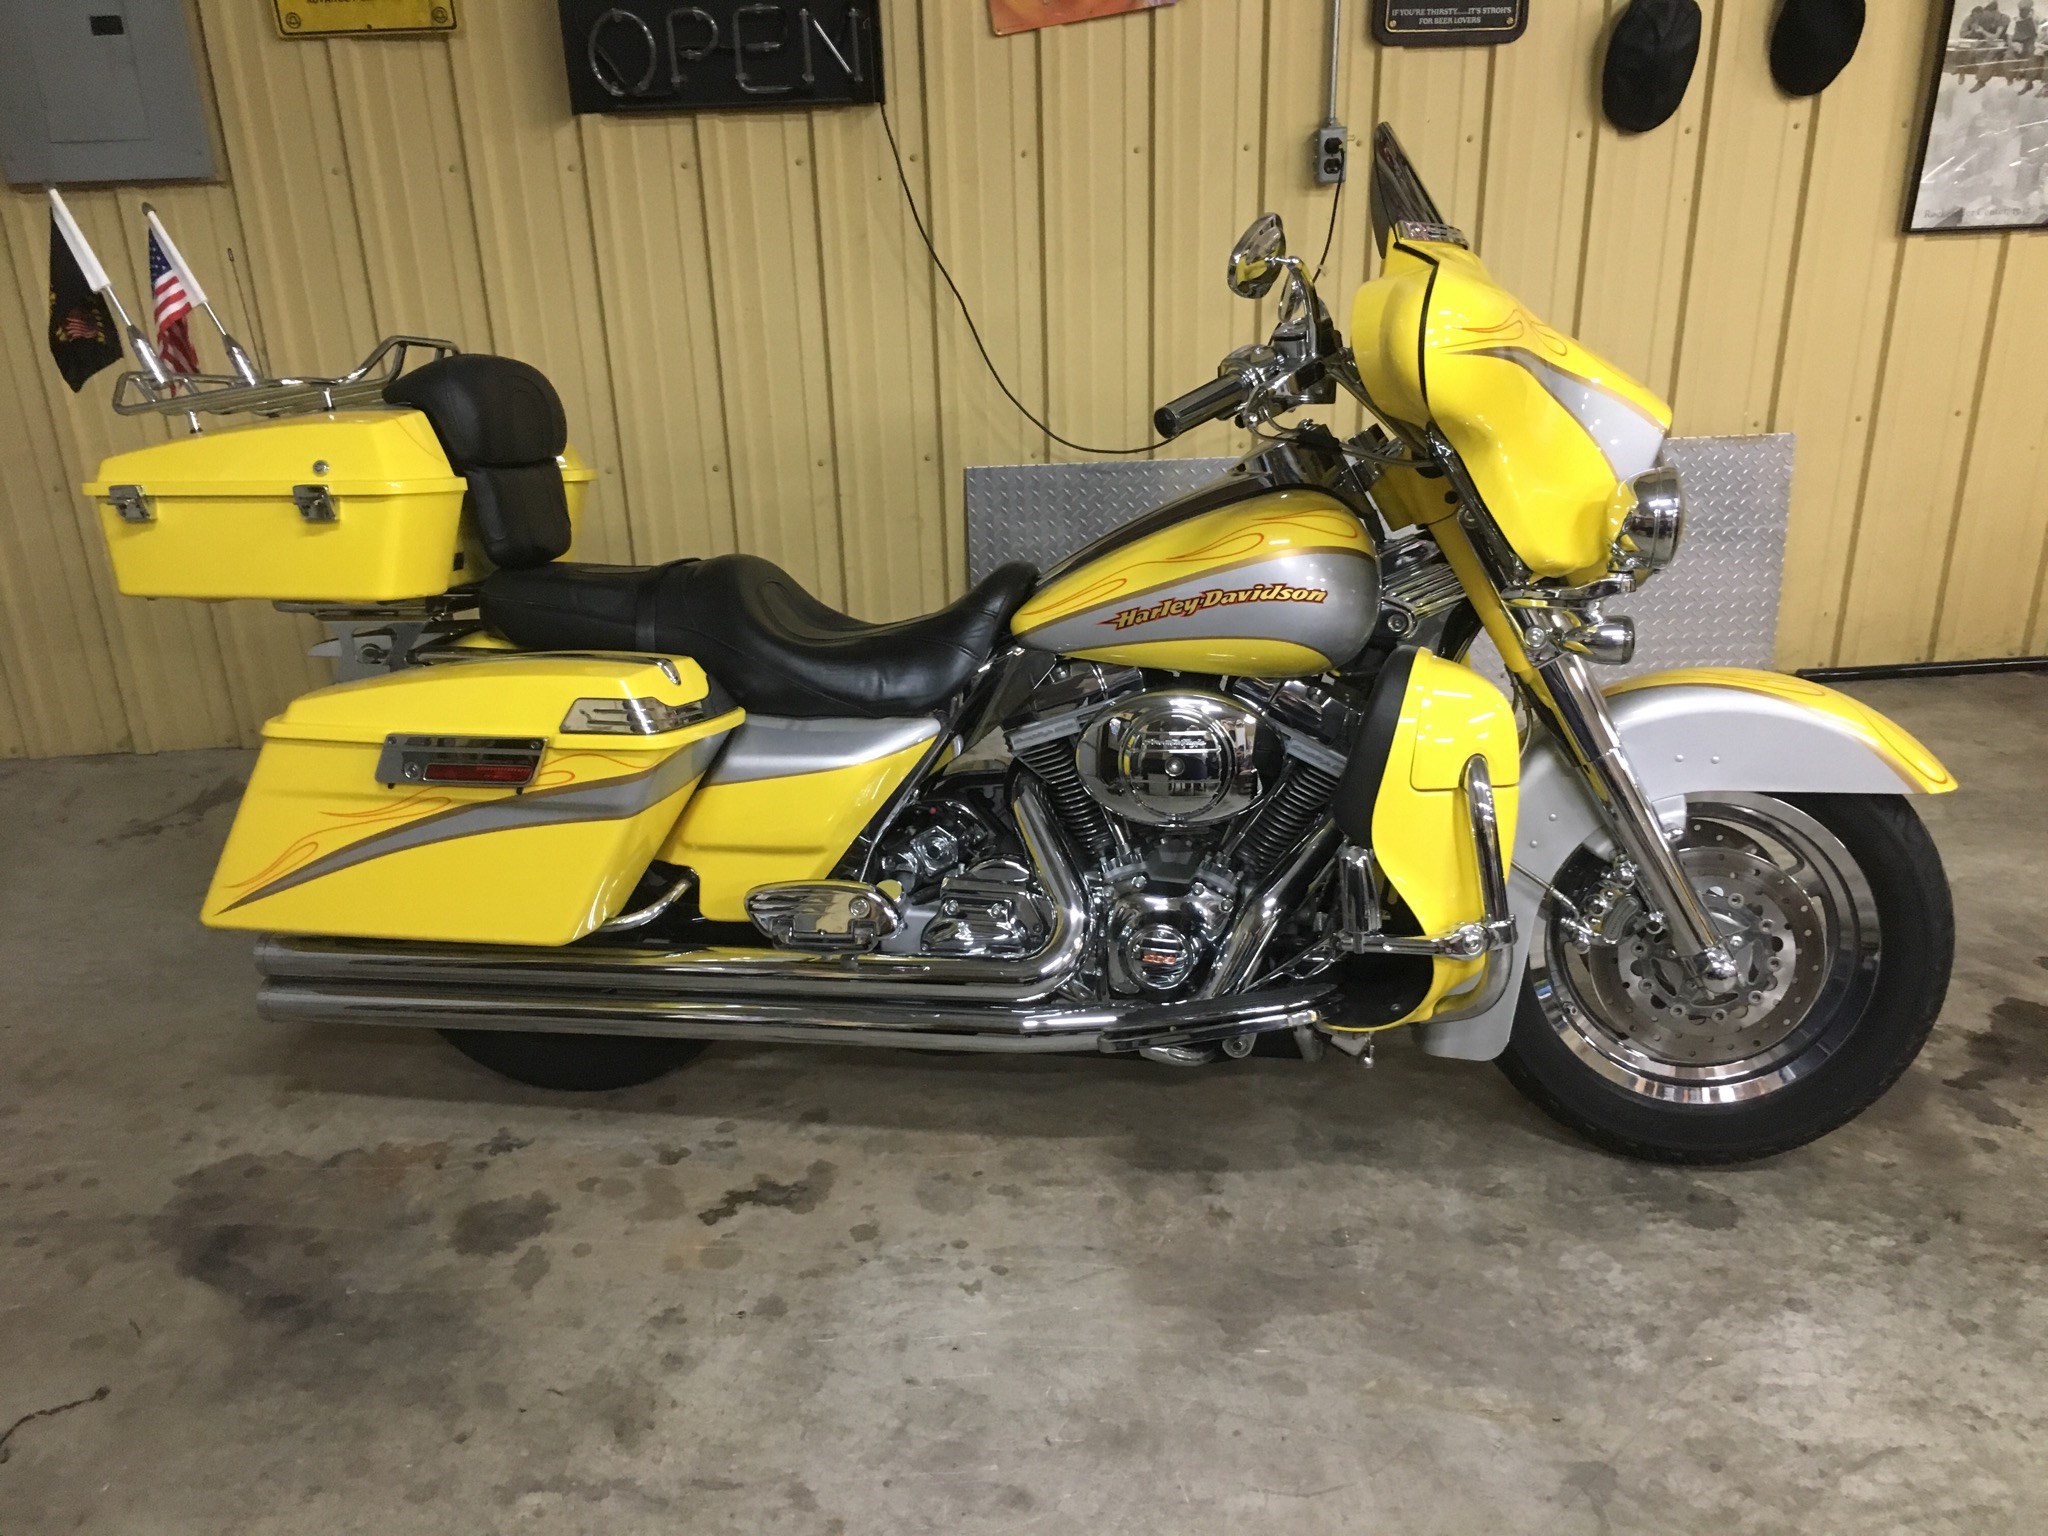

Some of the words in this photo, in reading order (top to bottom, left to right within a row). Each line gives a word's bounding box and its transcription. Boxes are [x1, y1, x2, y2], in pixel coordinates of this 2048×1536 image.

[1391, 9, 1400, 17] IF
[1418, 17, 1433, 25] FOR
[1434, 17, 1453, 25] BEER
[1454, 16, 1482, 24] LOVERS
[588, 5, 863, 95] OPEN
